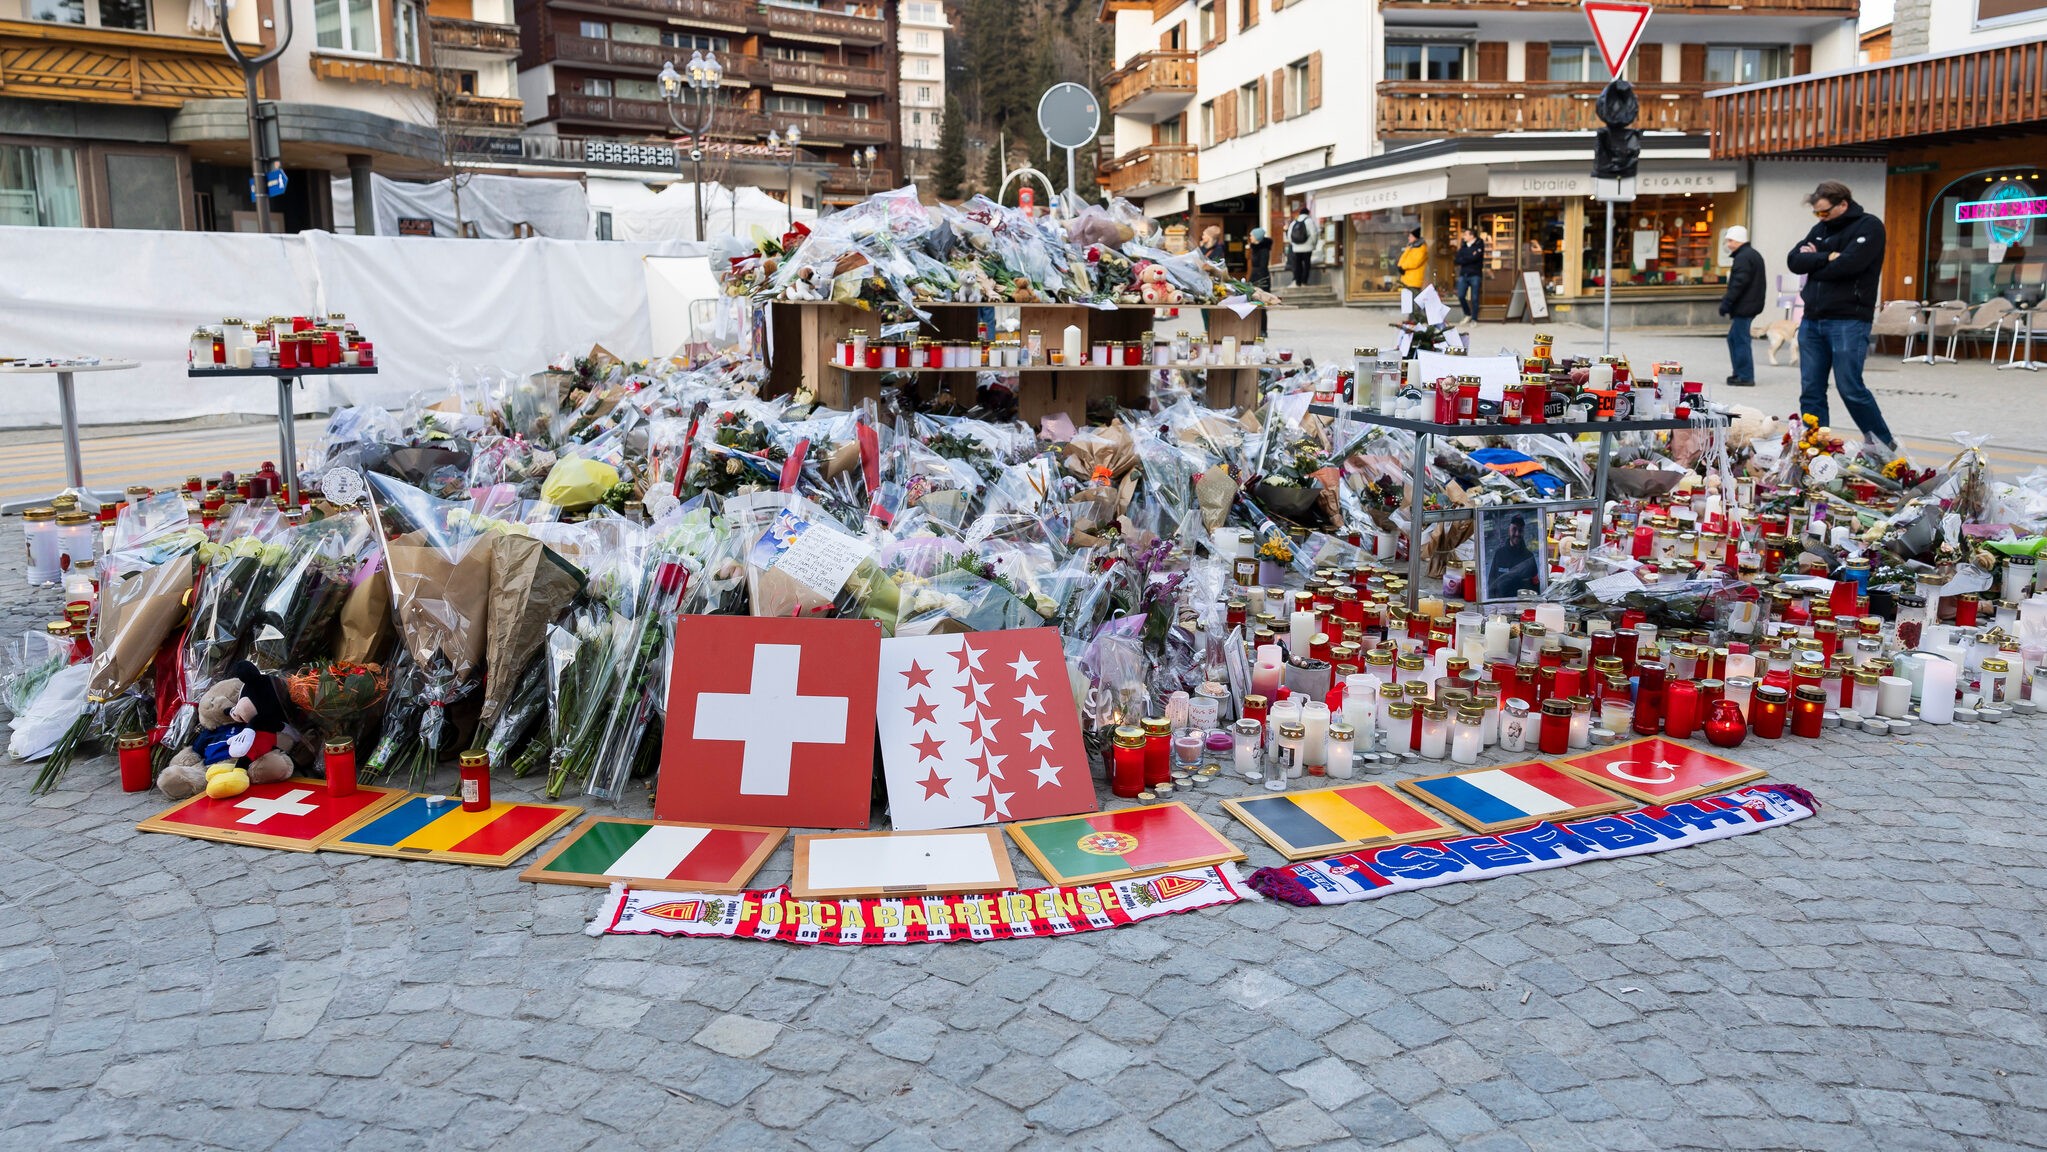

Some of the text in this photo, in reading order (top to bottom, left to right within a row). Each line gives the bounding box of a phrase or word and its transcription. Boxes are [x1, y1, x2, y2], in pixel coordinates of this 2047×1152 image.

[1522, 178, 1577, 191] Librairie
[1642, 176, 1715, 187] CIGARES
[1353, 191, 1398, 207] CIGARES
[1375, 802, 1747, 880] SERBIA
[1292, 864, 1338, 893] SERBIA
[740, 888, 1120, 930] FORÇA BARREIRENSE
